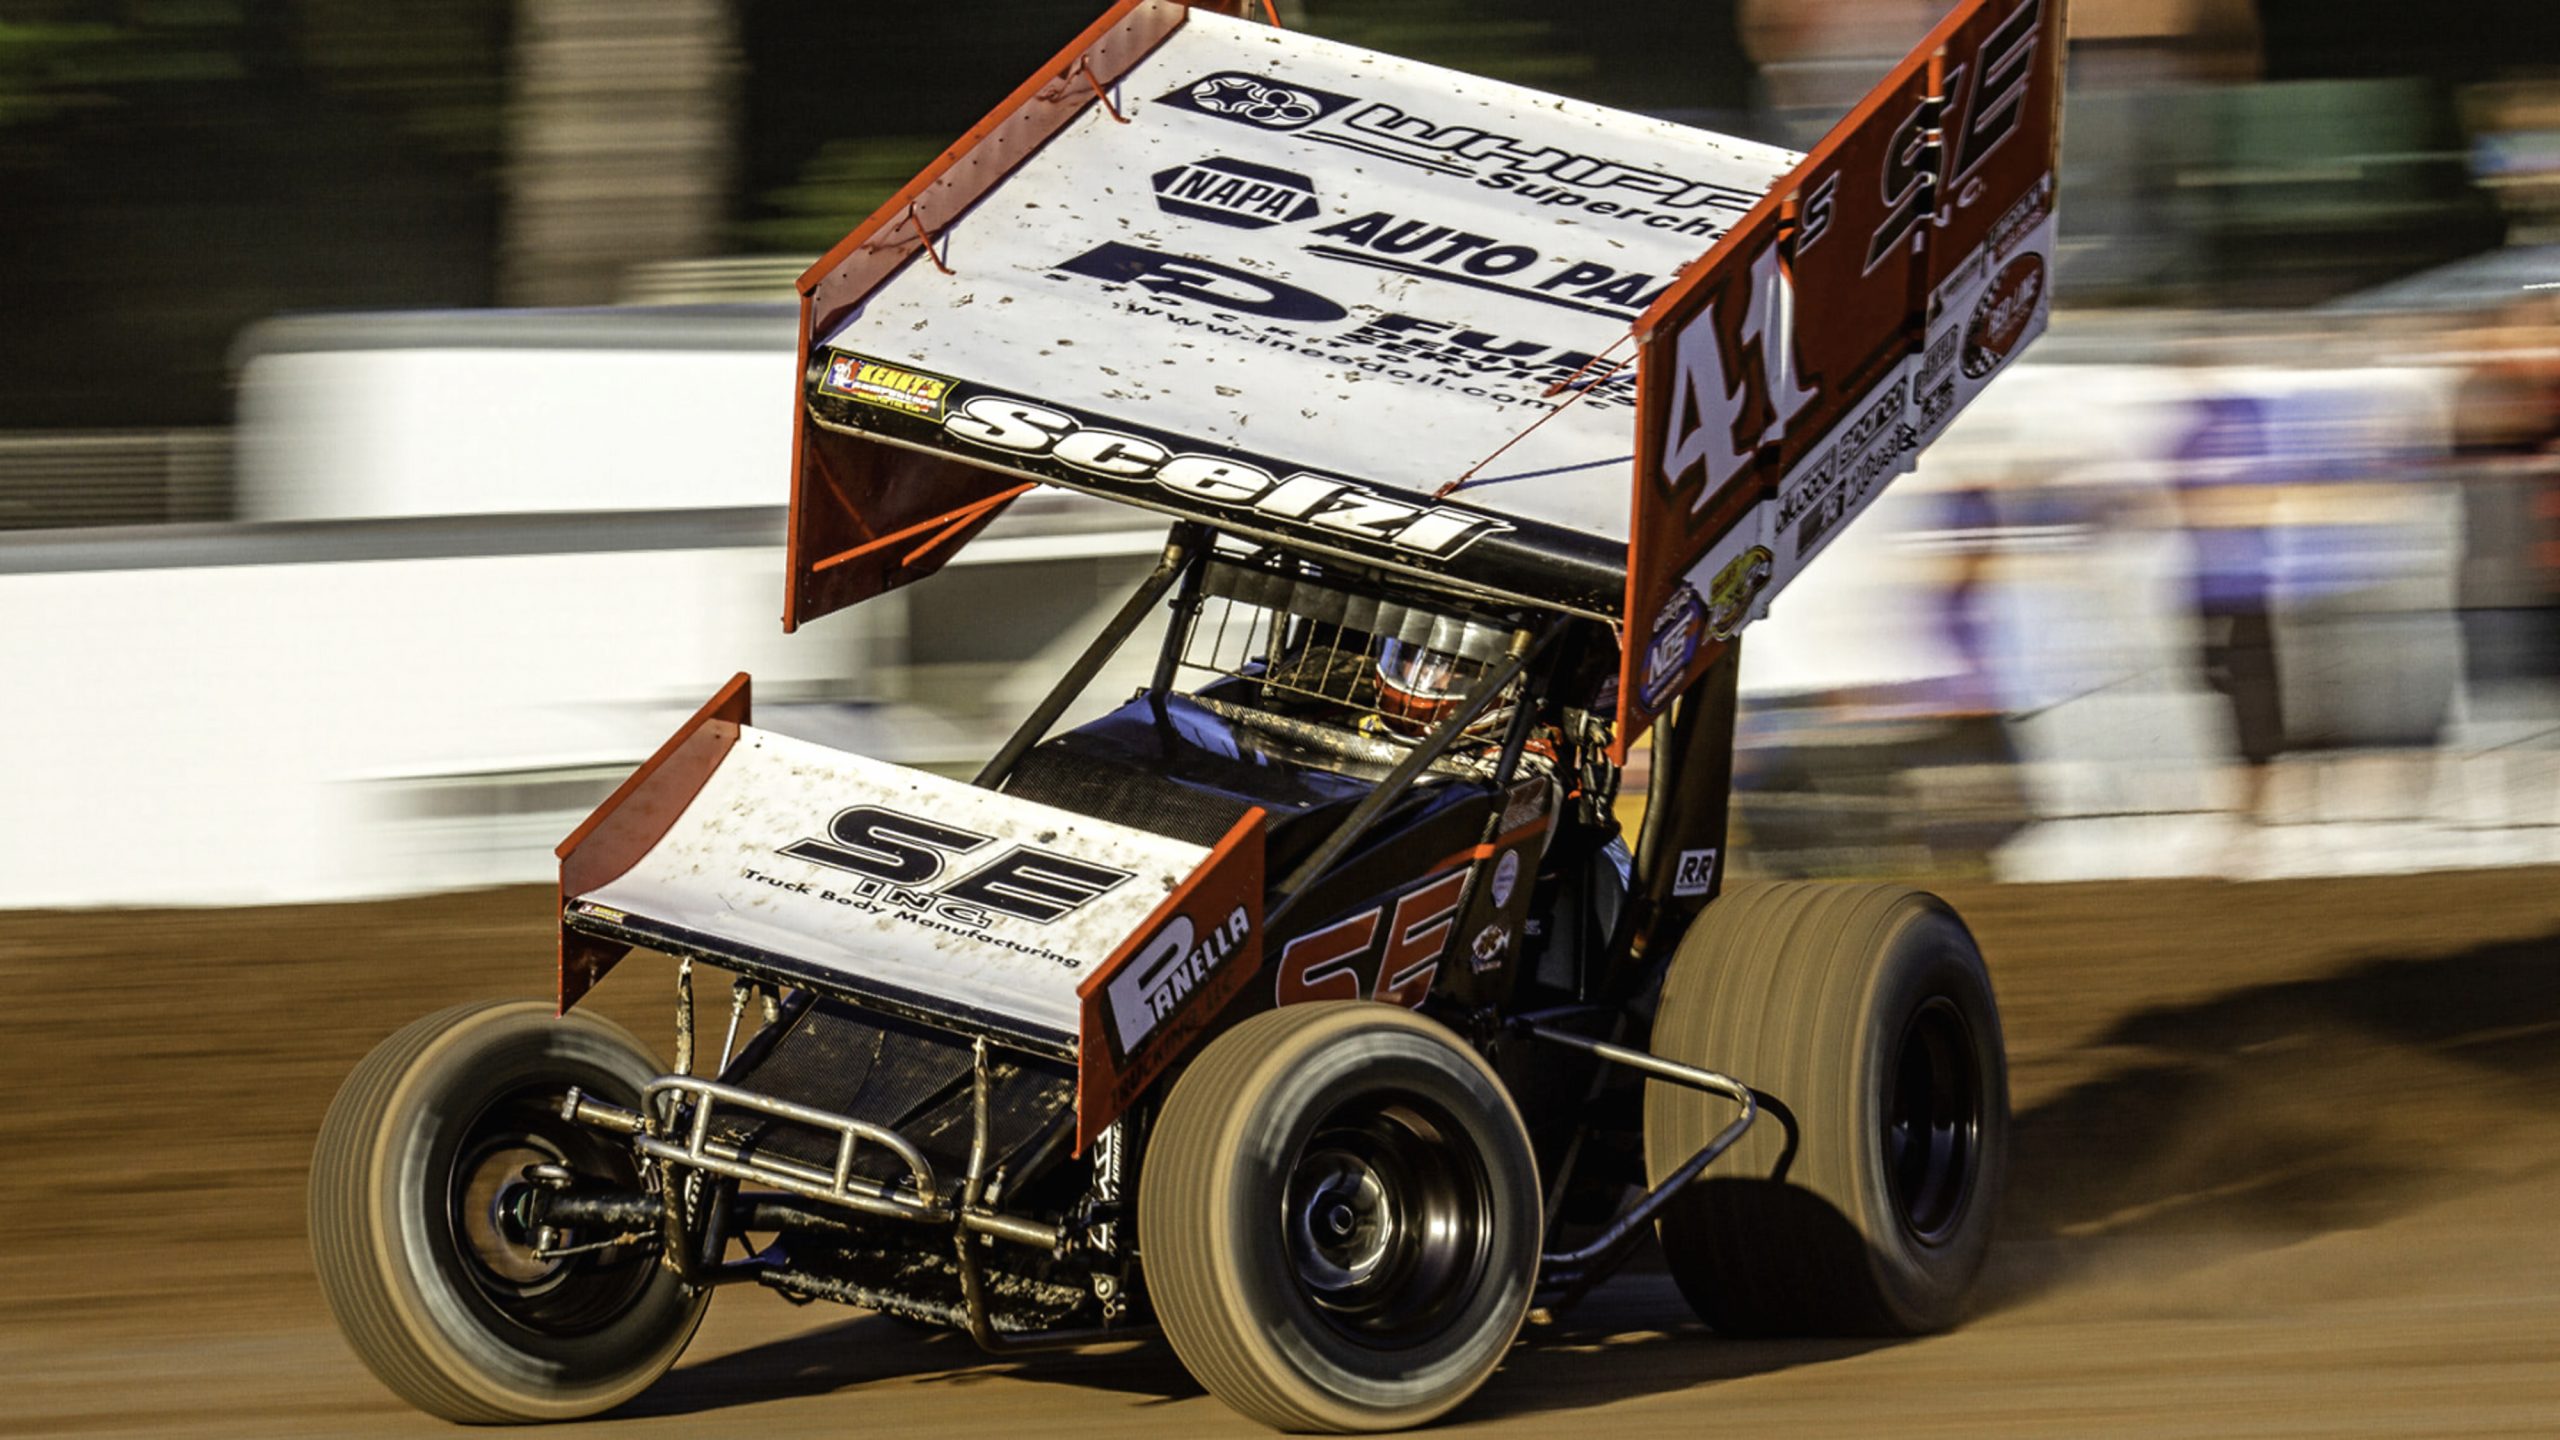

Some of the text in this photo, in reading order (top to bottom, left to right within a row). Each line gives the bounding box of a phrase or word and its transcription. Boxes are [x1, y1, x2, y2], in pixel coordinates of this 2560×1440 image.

[1177, 173, 1300, 223] NAPA
[1311, 210, 1538, 278] AUTO
[857, 363, 946, 399] KENNY'S
[1370, 313, 1637, 386] FUE
[1662, 240, 1820, 516] 41
[944, 394, 1514, 560] Scelzi
[774, 803, 1139, 926] SE
[1679, 854, 1713, 883] RR
[744, 868, 1082, 969] Truck Body Manufacturing
[1107, 905, 1250, 1056] PANELLA
